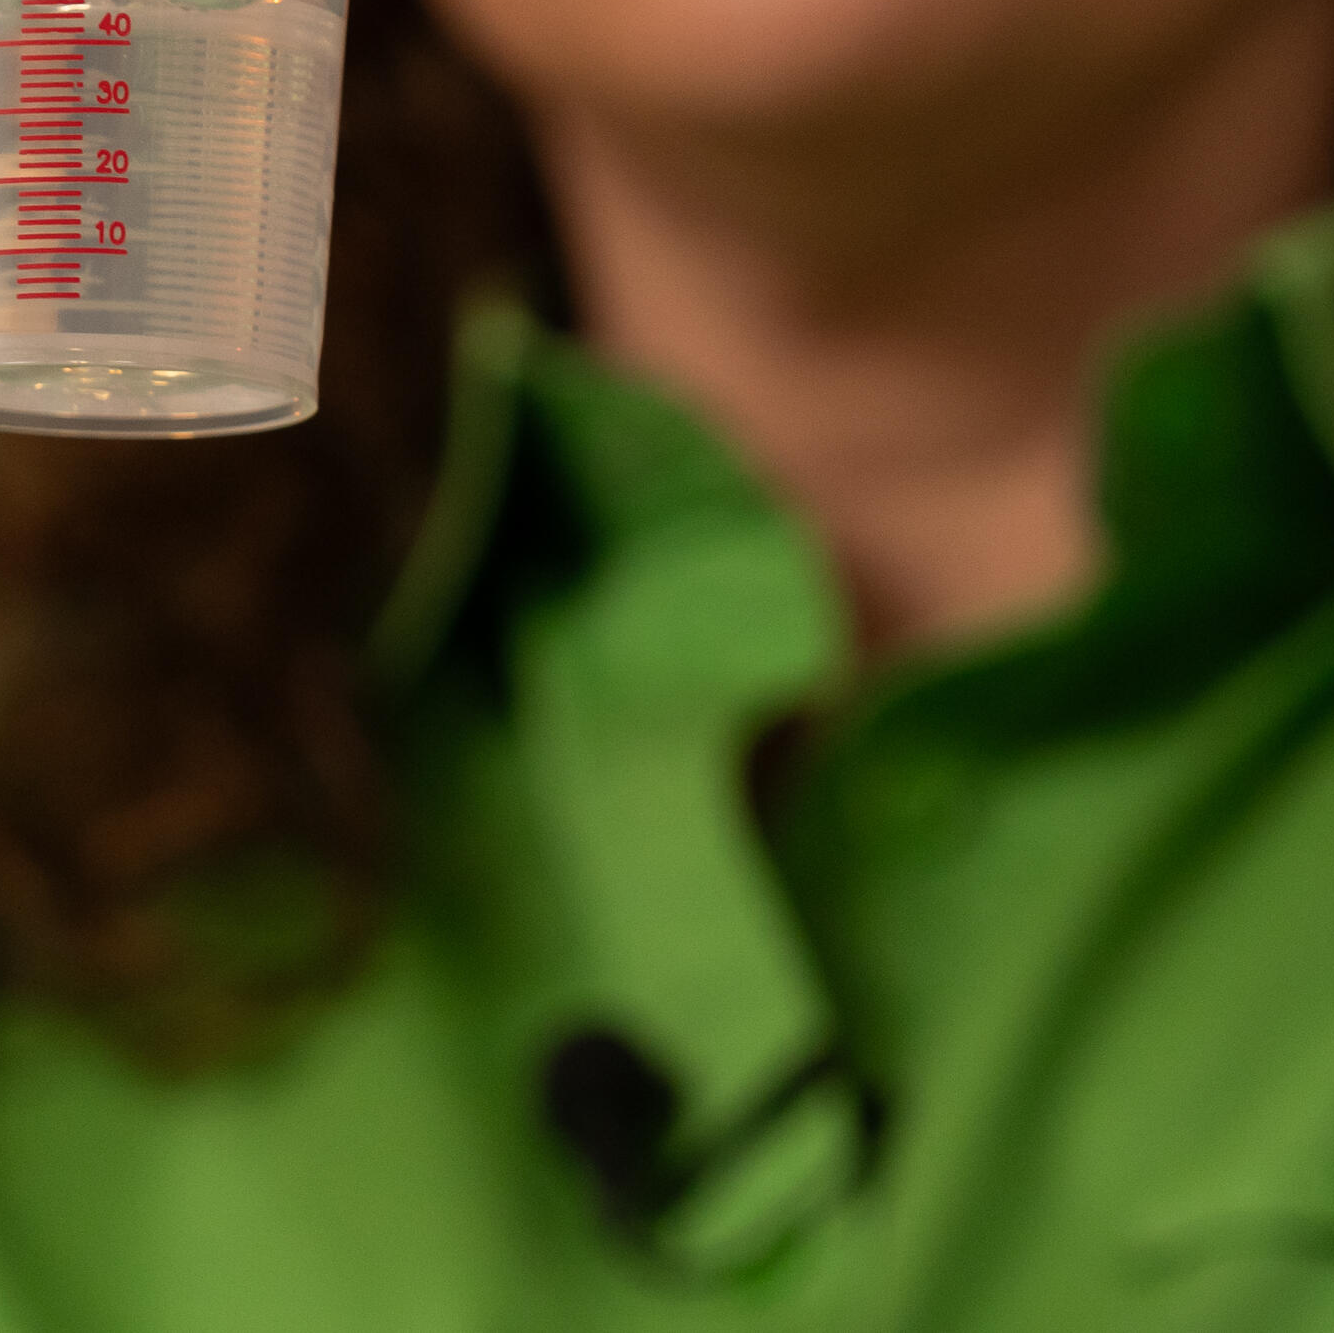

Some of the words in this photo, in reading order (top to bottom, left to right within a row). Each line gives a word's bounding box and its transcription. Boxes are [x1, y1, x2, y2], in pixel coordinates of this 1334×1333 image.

[98, 12, 132, 37] 40
[96, 80, 130, 105] 30
[95, 149, 129, 175] 20
[94, 220, 126, 246] 10
